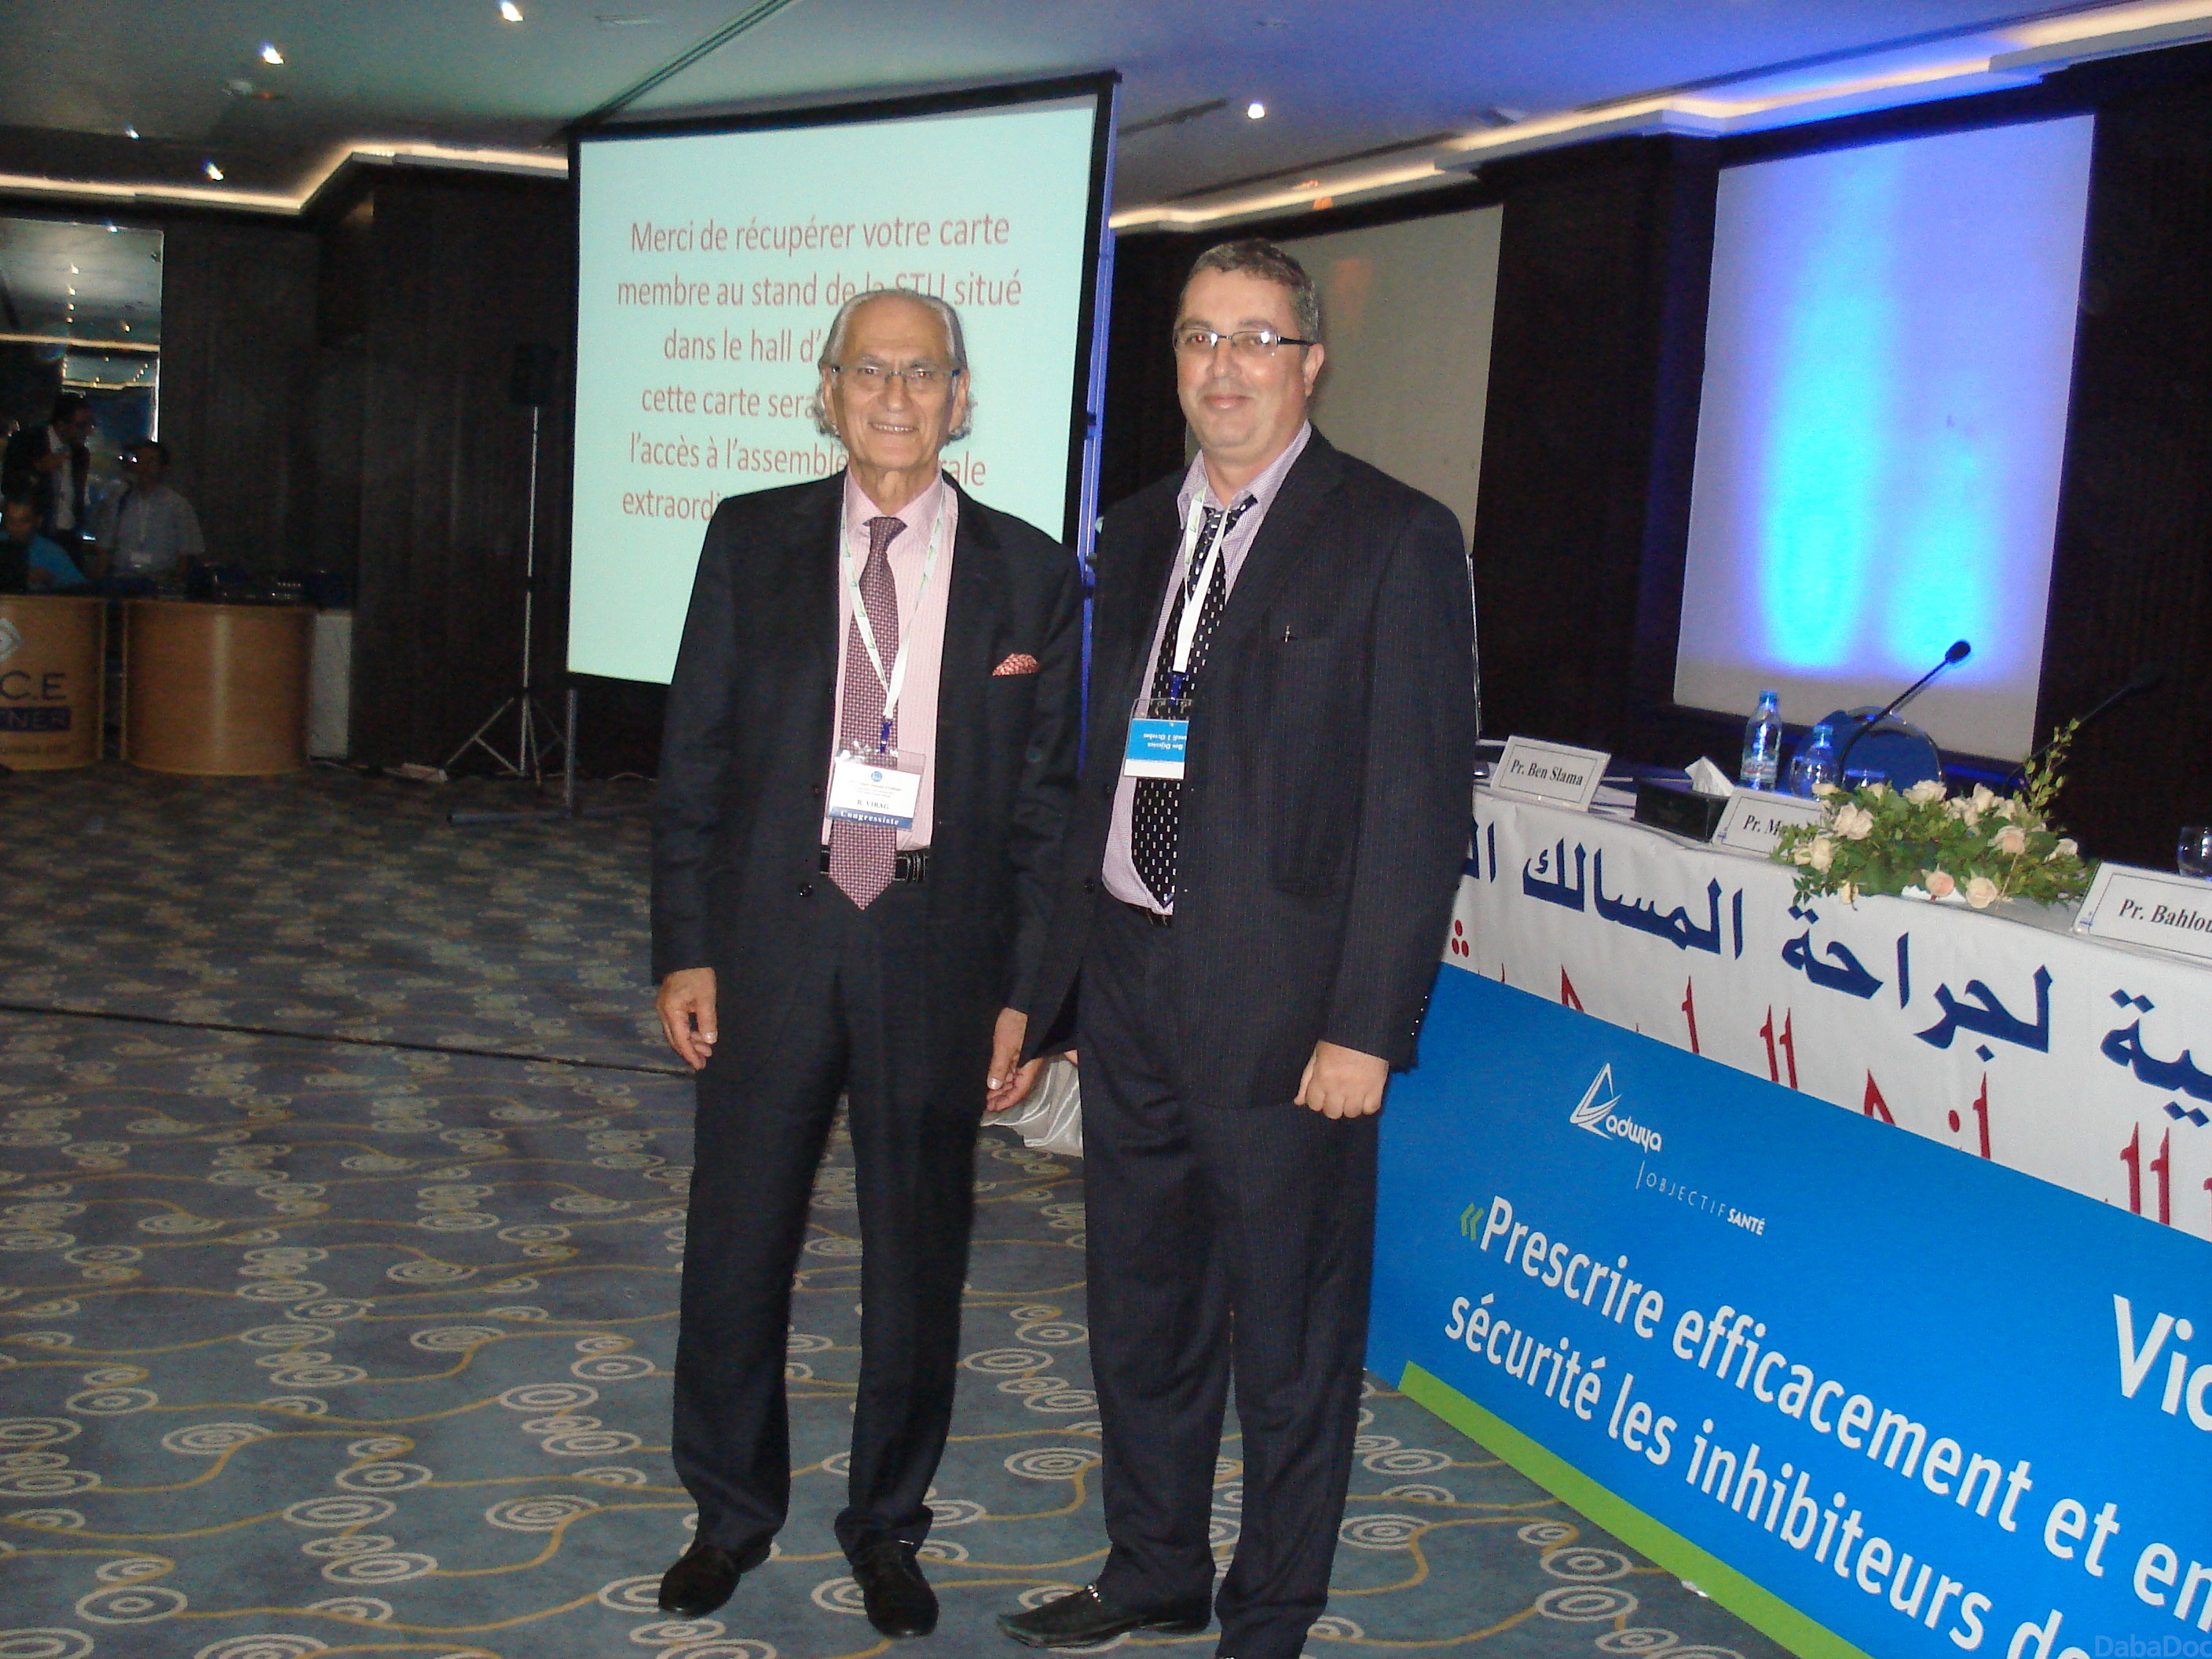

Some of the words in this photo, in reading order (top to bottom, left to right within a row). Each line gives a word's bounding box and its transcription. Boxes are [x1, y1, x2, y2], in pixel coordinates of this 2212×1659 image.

[631, 219, 694, 252] Merci
[700, 218, 727, 251] de
[736, 214, 855, 258] récupérer
[863, 217, 931, 248] votre
[939, 214, 1009, 247] carte
[618, 273, 710, 306] membre
[716, 281, 743, 306] au
[752, 272, 817, 306] stand
[826, 271, 856, 306] de
[954, 269, 1022, 306] situé
[664, 328, 716, 361] dans
[723, 327, 742, 361] le
[751, 328, 792, 361] hall
[642, 384, 697, 414] cette
[703, 386, 760, 416] carte
[631, 431, 700, 469] l'accès
[706, 435, 718, 469] à
[1511, 759, 1525, 775] Pr.
[1527, 762, 1547, 779] Ben
[1549, 766, 1583, 786] Slama
[1743, 815, 1761, 833] Pr.
[1522, 837, 1742, 960] المسالك
[2119, 899, 2144, 921] Pr.
[1782, 905, 2053, 1062] لجراحة
[1606, 1115, 1662, 1153] adwya
[1646, 1173, 1727, 1217] OBJECTIF
[1727, 1208, 1765, 1236] SANTÉ
[1445, 1293, 1606, 1420] sécurité
[1608, 1372, 1677, 1466] les
[1685, 1419, 1994, 1650] inhibiteurs
[1672, 1305, 2033, 1533] efficacement
[2043, 1496, 2119, 1577] et
[2133, 1542, 2212, 1633] en
